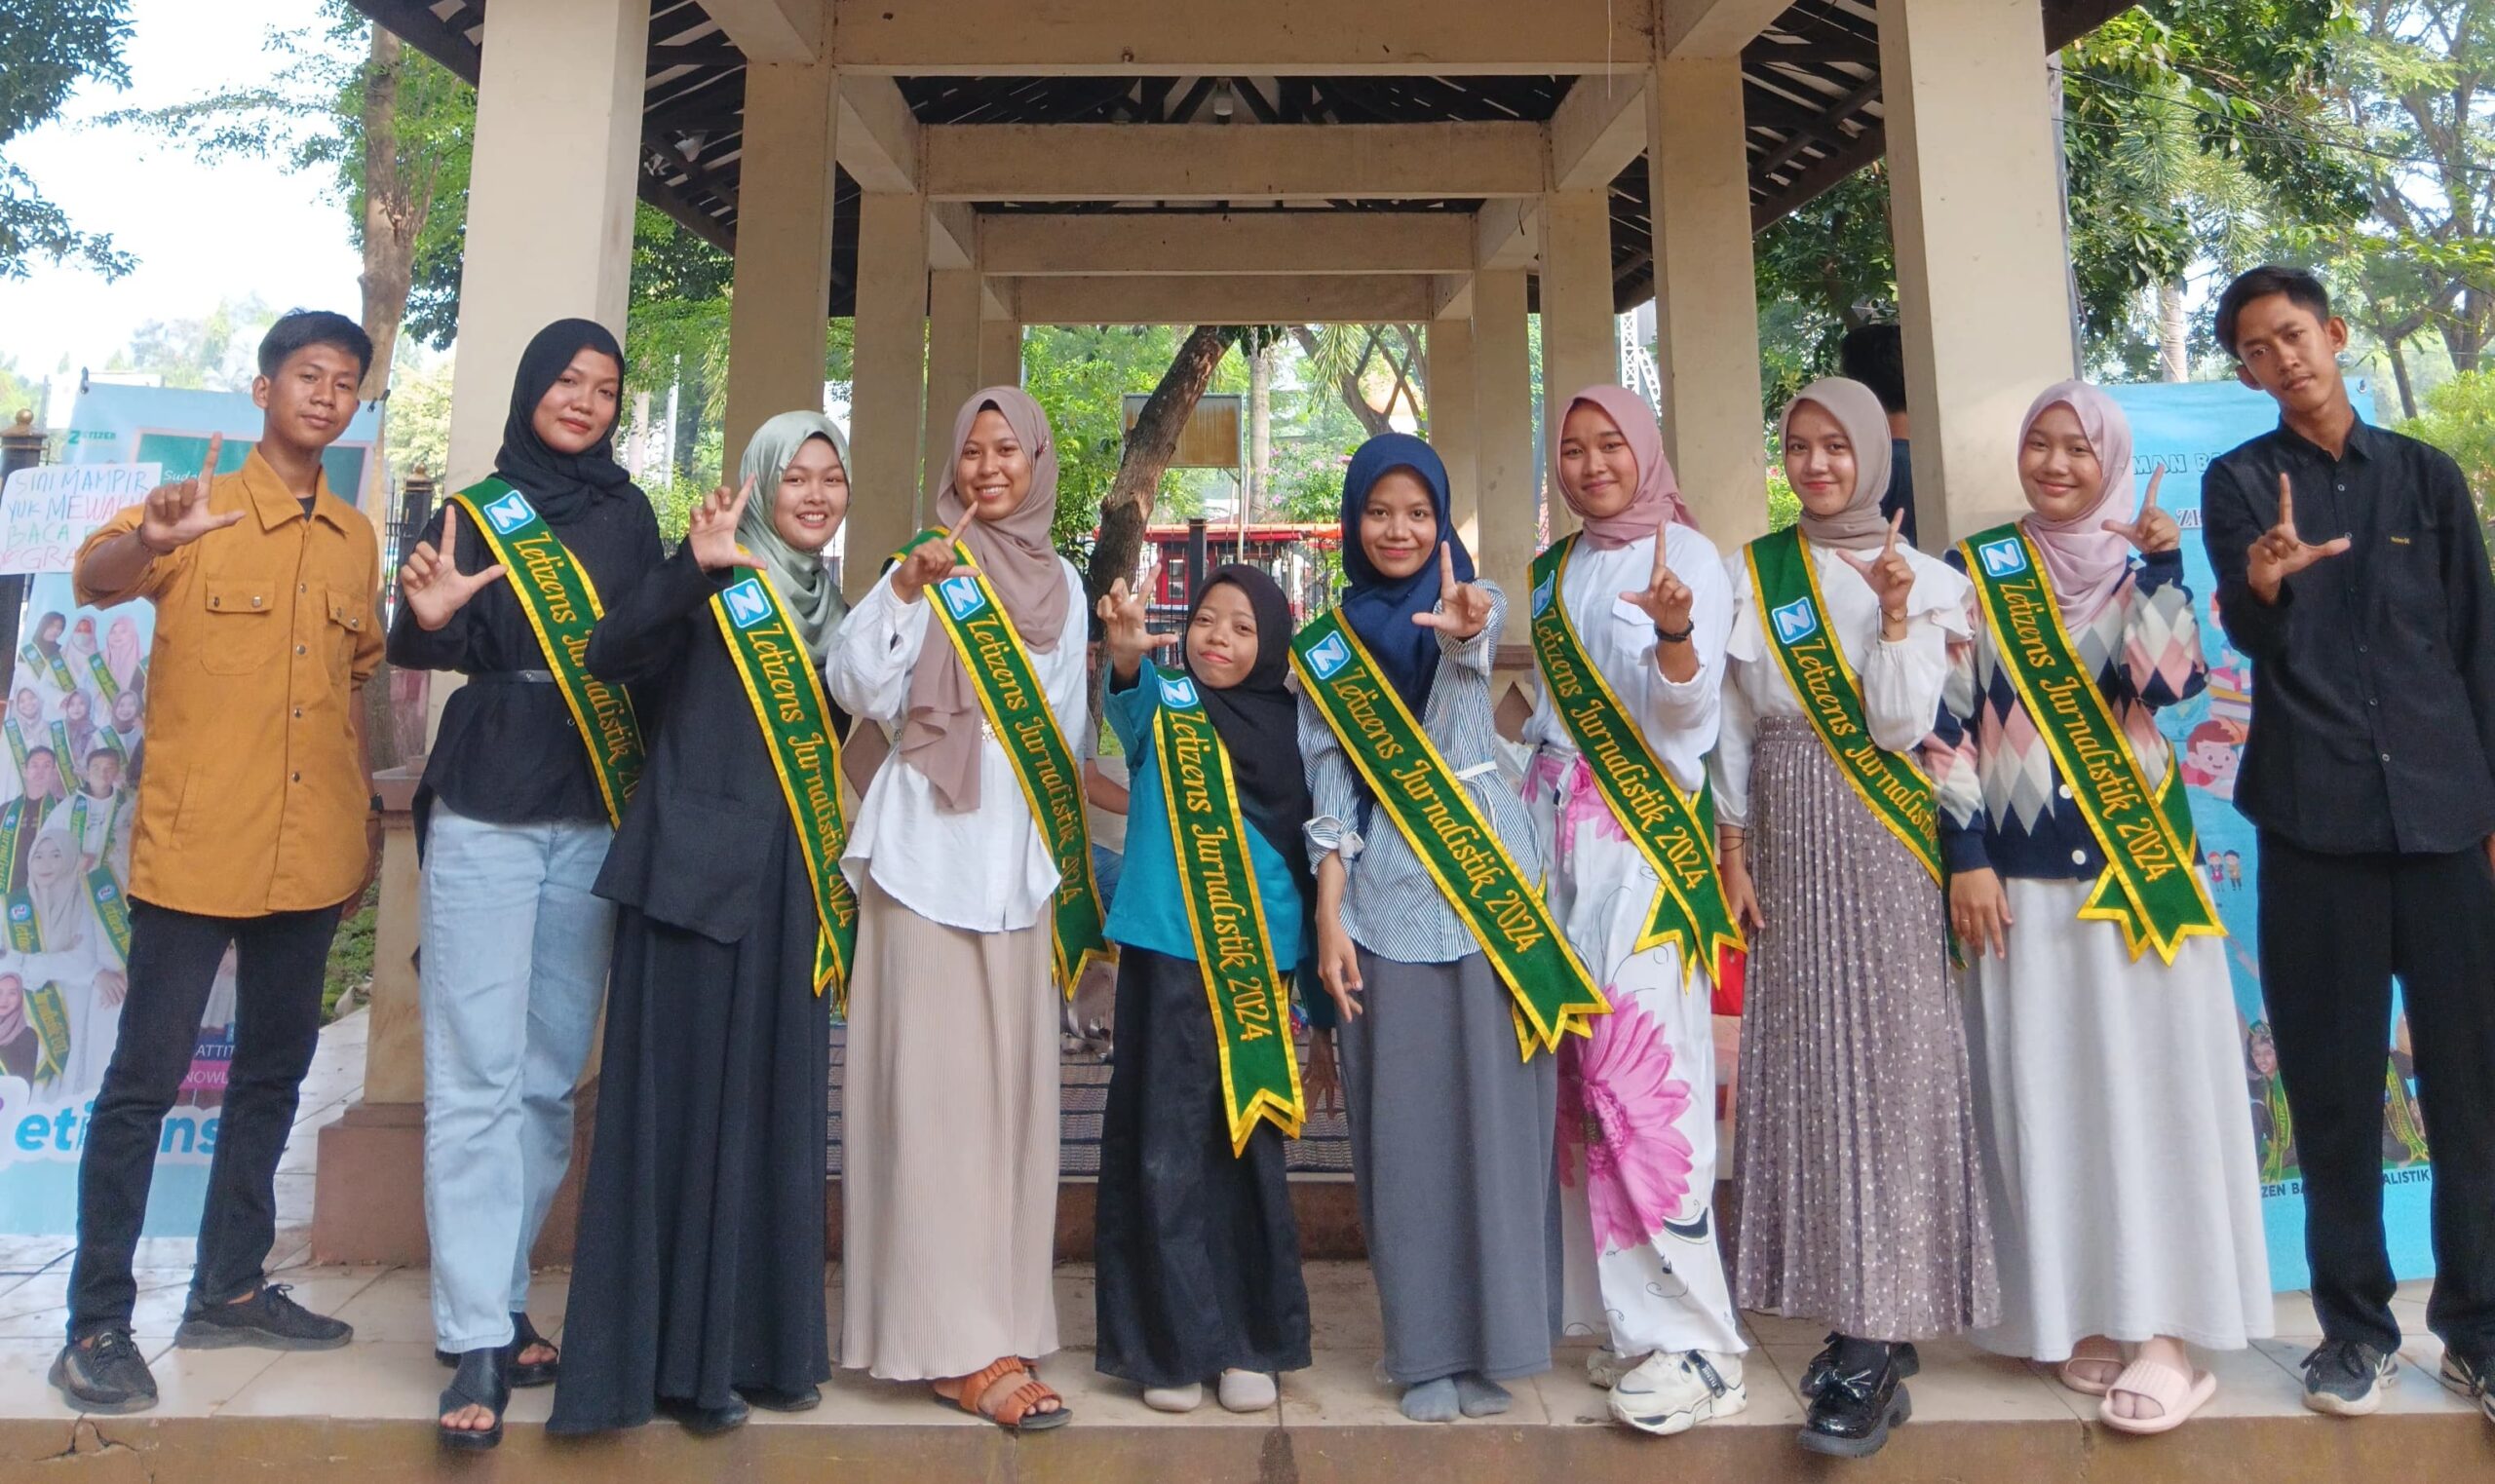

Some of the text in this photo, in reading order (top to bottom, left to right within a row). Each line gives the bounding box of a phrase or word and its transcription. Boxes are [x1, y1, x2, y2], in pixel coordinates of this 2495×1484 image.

[6, 523, 70, 550] BACA
[8, 498, 40, 522] YUK
[61, 468, 149, 494] MAMPIR
[513, 531, 577, 624] Zetizens
[562, 628, 633, 767] Junalistik
[747, 623, 805, 724] Zetizens
[788, 732, 844, 872] Jurnalistik
[966, 613, 1028, 711] Zetizens
[1017, 716, 1079, 852] Jurnalistik
[1536, 607, 1583, 698] Zetizens
[1571, 700, 1674, 833] Jurnalistik
[1654, 824, 1708, 891] 2024
[1790, 637, 1858, 738] Zetizens
[1999, 579, 2177, 884] Zetizens Jurnalistik 2024
[1169, 711, 1273, 1042] Zetizens Jurnalistik 2024
[1330, 666, 1546, 954] Zetizens Jurnalistik 2024
